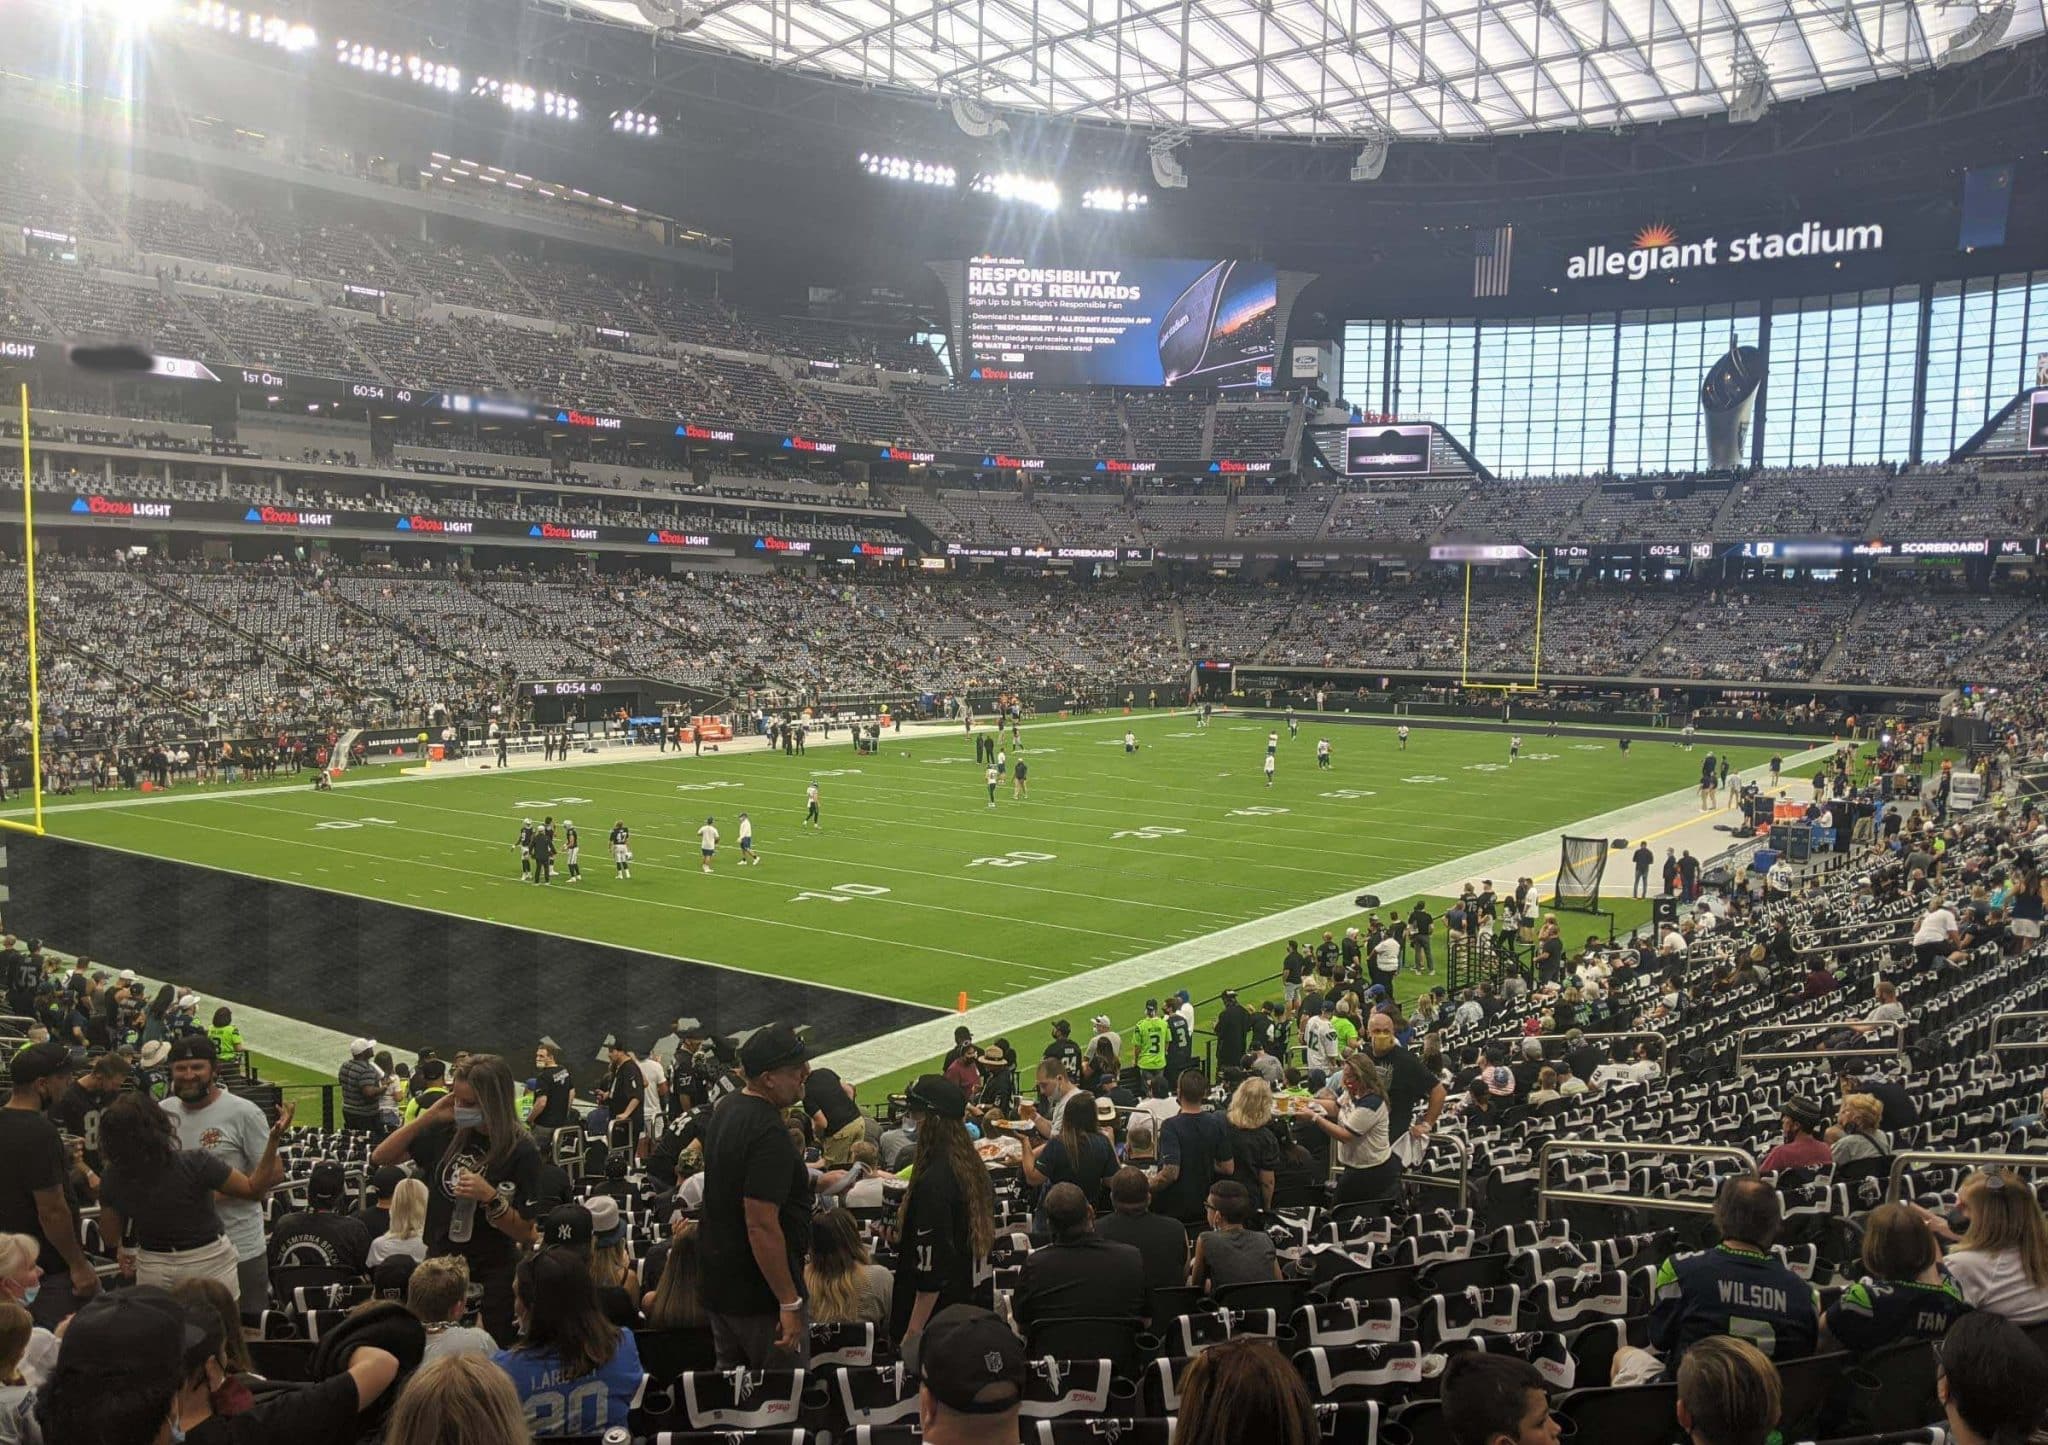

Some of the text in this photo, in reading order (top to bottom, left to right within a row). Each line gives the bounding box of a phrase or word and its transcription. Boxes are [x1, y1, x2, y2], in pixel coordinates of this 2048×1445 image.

[1567, 222, 1882, 281] allegiant stadium
[969, 267, 1121, 284] RESPONSIBILITY
[969, 282, 1141, 300] HAS ITS REWARDS
[969, 298, 986, 307] Sign
[988, 299, 999, 307] Up
[1023, 300, 1058, 308] Tonight's
[1060, 301, 1105, 310] Responsible
[0, 342, 35, 359] IGHT
[1009, 371, 1034, 379] LIGHT
[353, 385, 384, 399] 60:54
[397, 391, 411, 401] 40
[596, 418, 621, 429] LIGHT
[711, 430, 734, 441] LIGHT
[816, 442, 836, 452] LIGHT
[912, 453, 935, 462] LIGHT
[1021, 459, 1044, 468] LIGHT
[1132, 462, 1156, 472] LIGHT
[1246, 462, 1271, 471] LIGHT
[89, 496, 171, 516] Coors LIGHT
[261, 507, 332, 525] Coors LIGHT
[444, 521, 472, 533] LIGHT
[571, 529, 598, 540] LIGHT
[685, 536, 709, 546] LIGHT
[789, 541, 811, 551] LIGHT
[884, 547, 903, 556] LIGHT
[1650, 546, 1679, 555] 60:54
[1692, 545, 1709, 556] 40
[1901, 543, 1984, 553] SCOREBOARD
[2002, 542, 2022, 552] NFL
[1058, 549, 1114, 557] SCOREBOARD
[1128, 550, 1142, 558] NFL
[556, 683, 601, 694] 60:54 40
[1112, 826, 1187, 839] 30
[970, 851, 1057, 868] 20
[795, 883, 891, 903] 10
[1660, 904, 1670, 914] C
[20, 965, 37, 987] 75
[1177, 1028, 1187, 1047] 3
[1149, 1035, 1160, 1053] 3
[680, 1076, 692, 1086] 37
[558, 1224, 572, 1240] NY
[287, 1233, 321, 1247] SMYRNA
[916, 1245, 933, 1272] 11
[1718, 1280, 1786, 1313] WILSON
[1917, 1311, 1947, 1331] FAN
